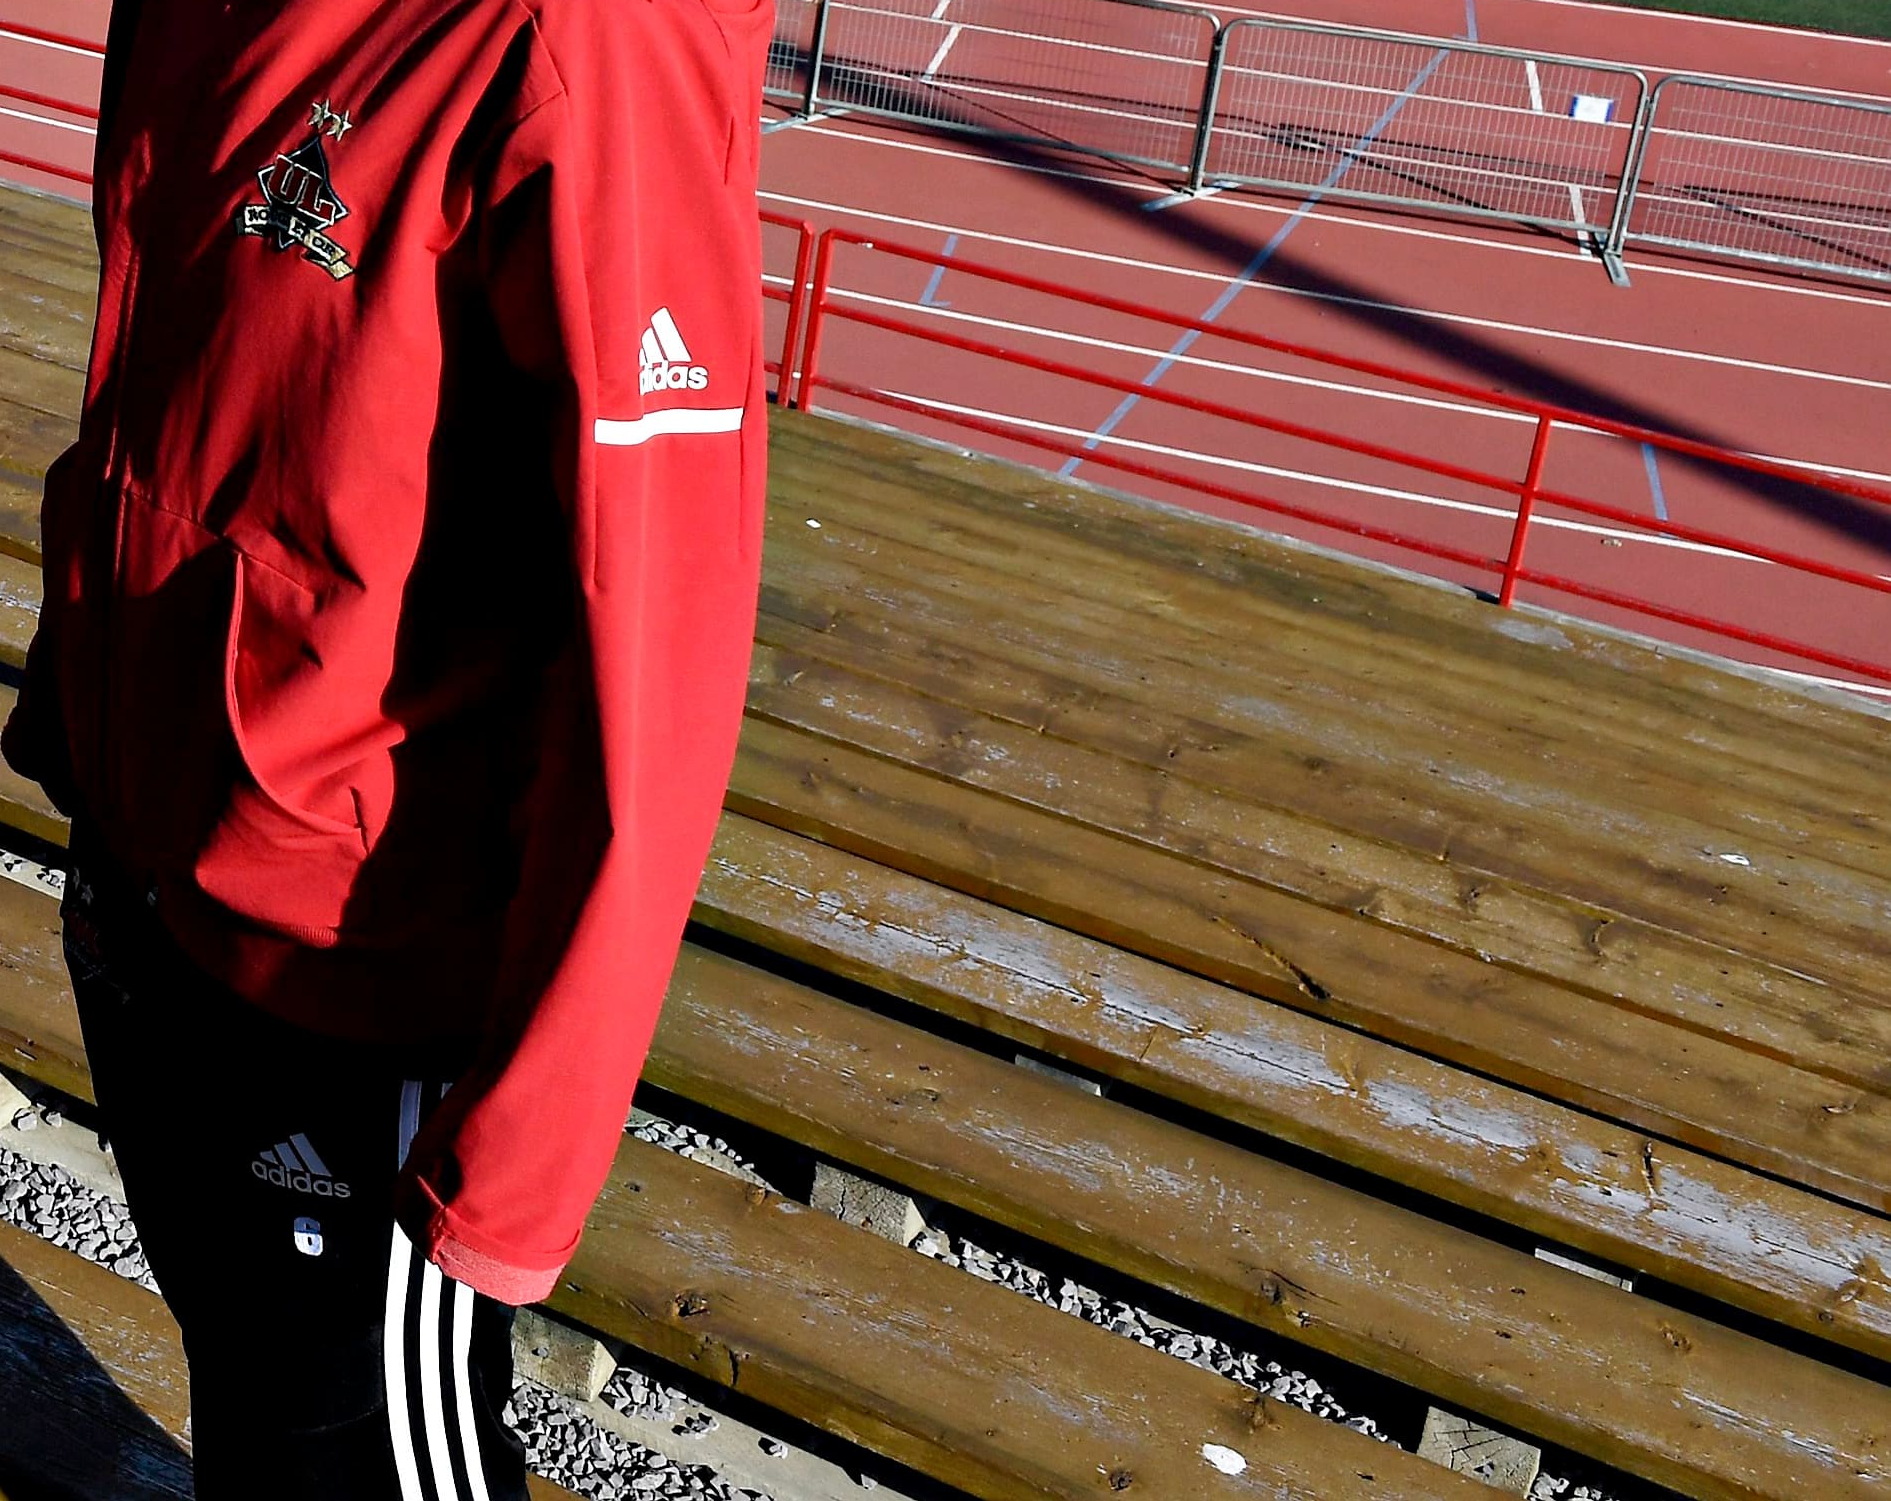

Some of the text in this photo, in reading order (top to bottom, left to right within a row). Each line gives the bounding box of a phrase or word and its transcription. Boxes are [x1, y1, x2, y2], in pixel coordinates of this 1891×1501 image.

[267, 153, 337, 227] UL
[639, 359, 710, 397] didas
[251, 1160, 352, 1198] adidas
